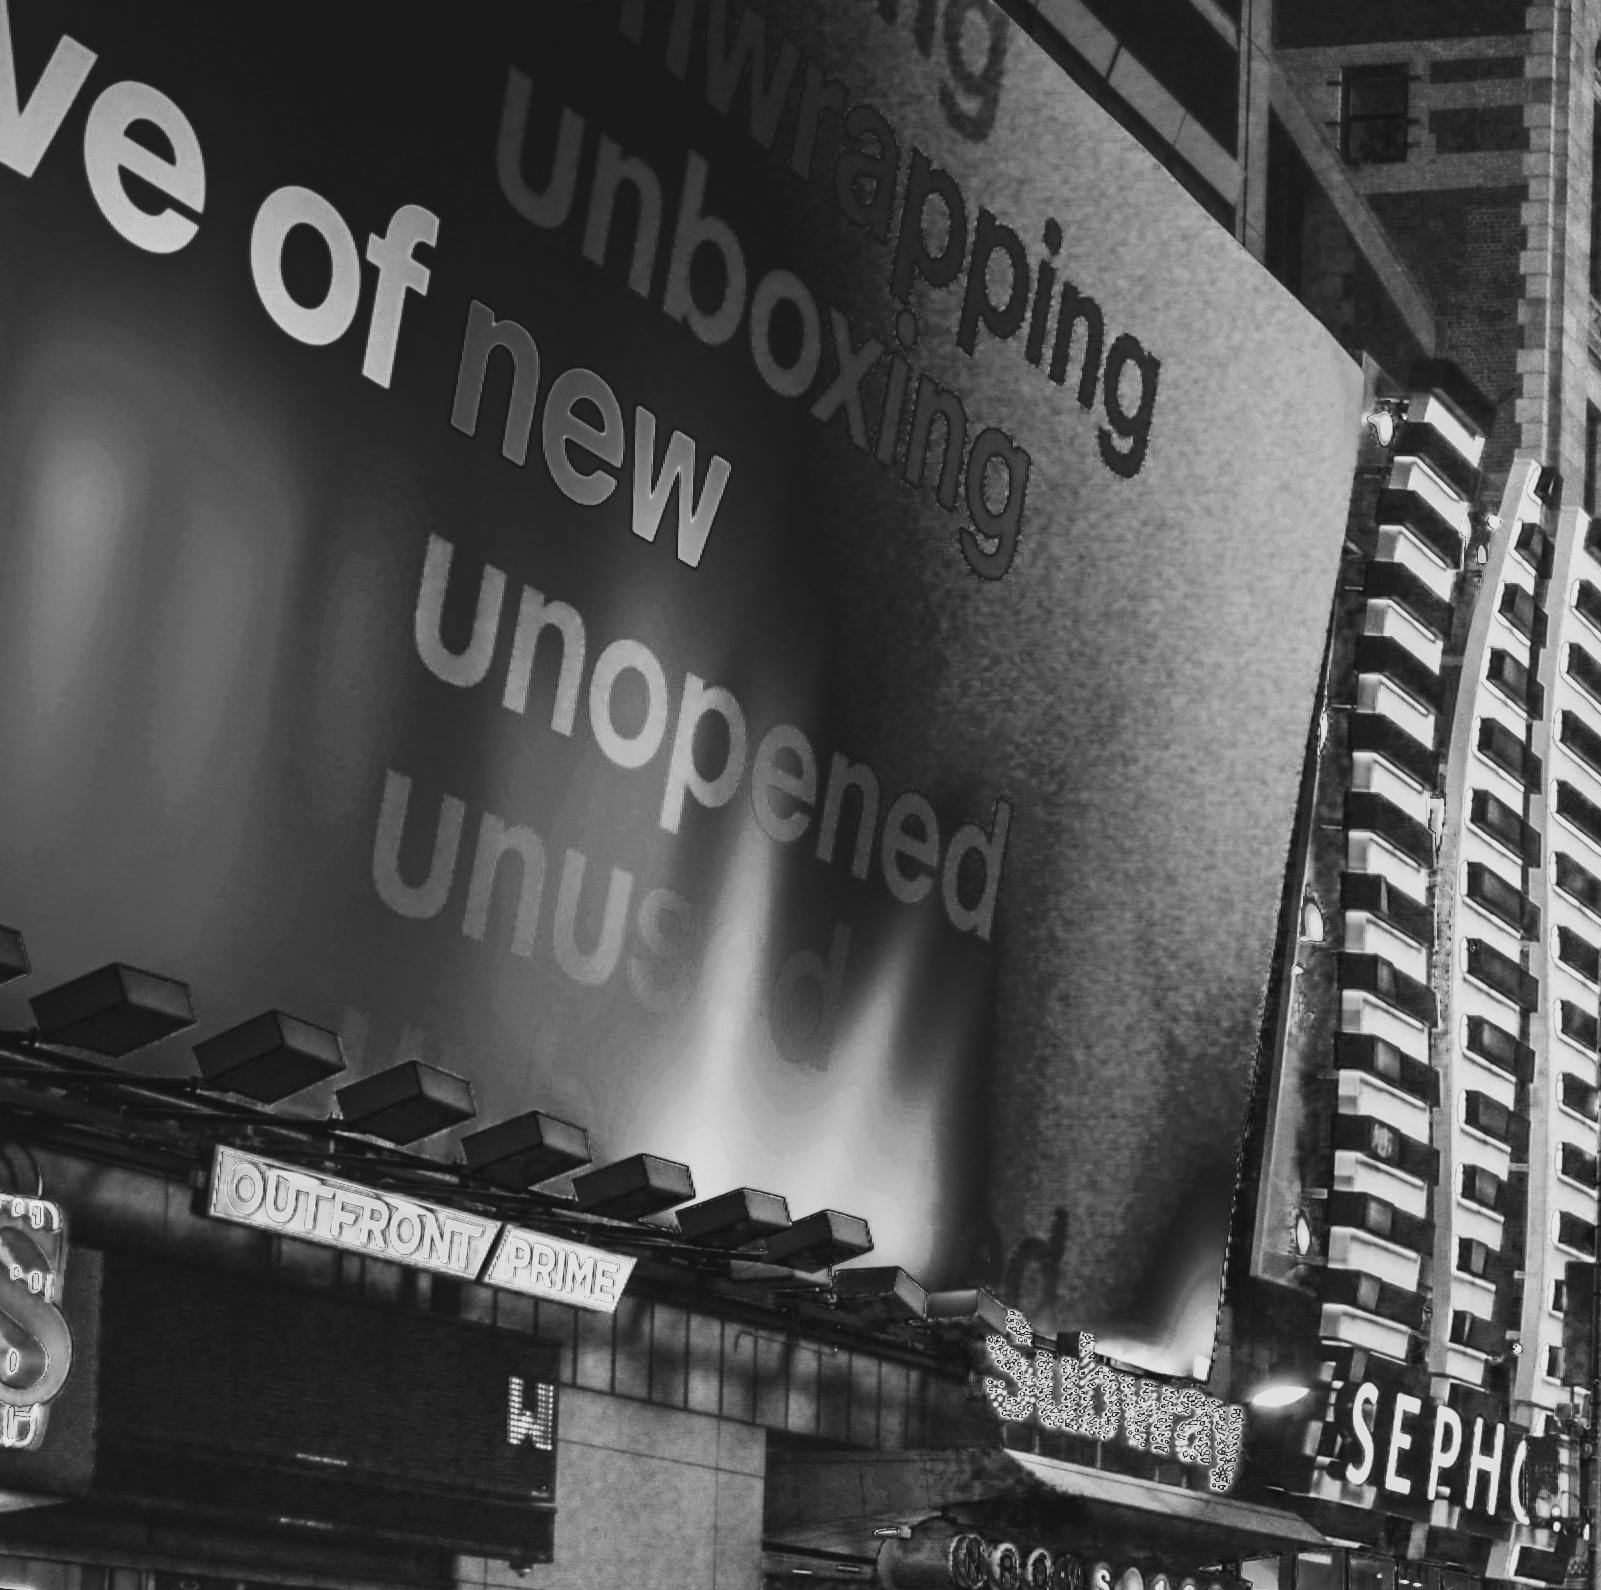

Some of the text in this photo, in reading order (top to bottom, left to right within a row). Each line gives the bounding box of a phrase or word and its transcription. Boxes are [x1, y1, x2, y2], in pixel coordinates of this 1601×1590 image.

[250, 185, 440, 388] of
[451, 298, 732, 568] new
[495, 65, 1032, 581] unboxing
[413, 532, 1012, 940] unopened
[225, 1160, 621, 1300] OUTFRONT PRIME
[984, 1307, 1245, 1493] Subway
